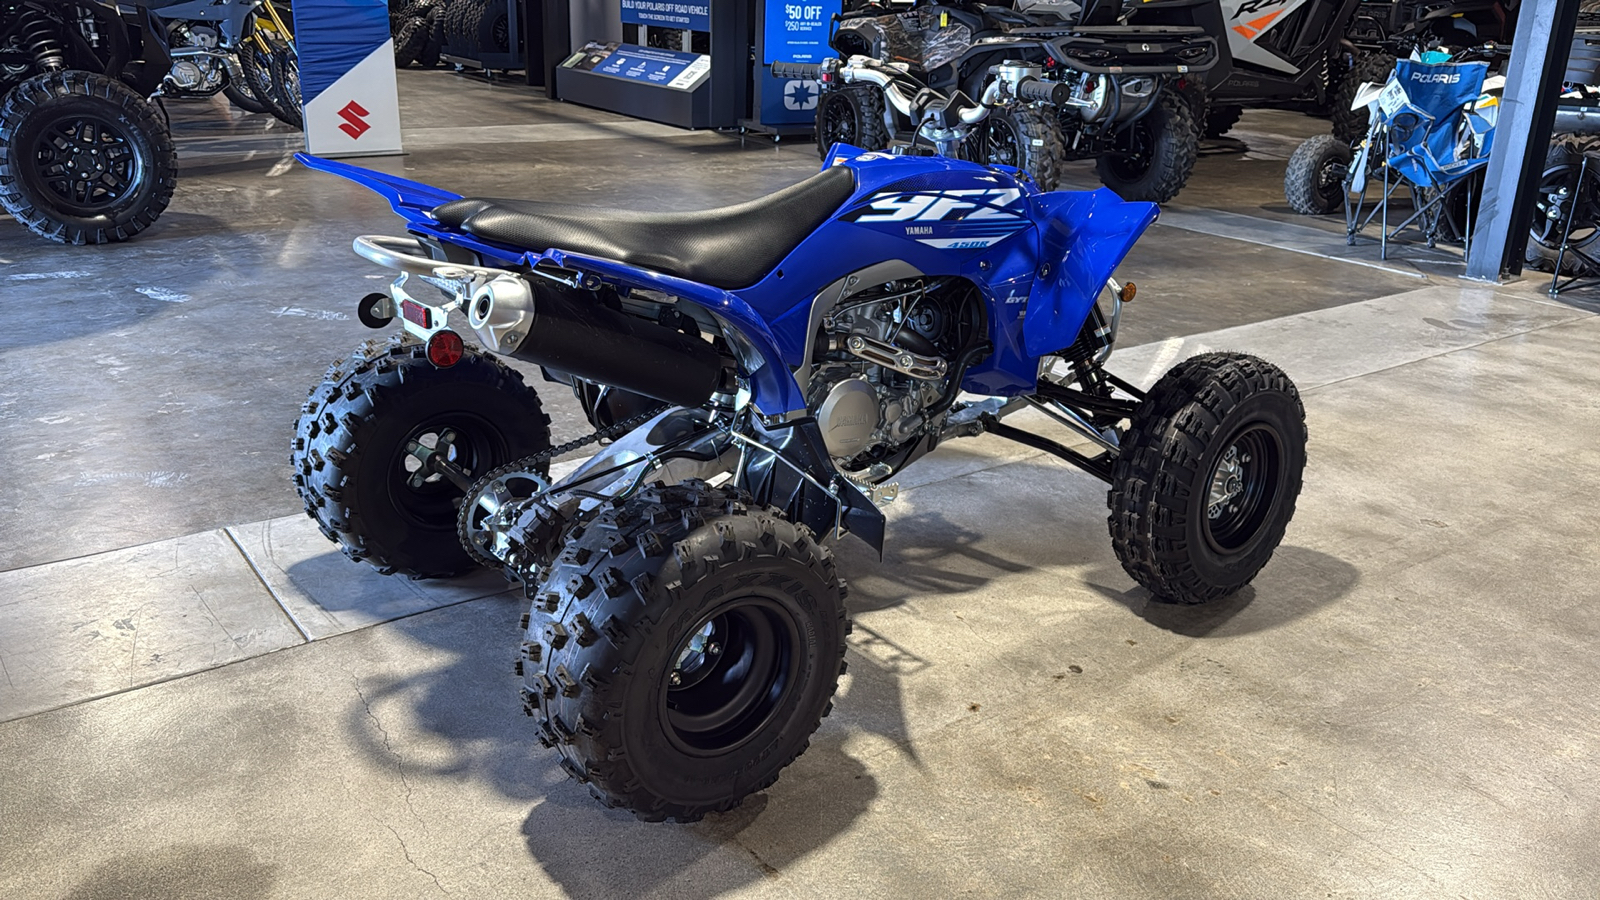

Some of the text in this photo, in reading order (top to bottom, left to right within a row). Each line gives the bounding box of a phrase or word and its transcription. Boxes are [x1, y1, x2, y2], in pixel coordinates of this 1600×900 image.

[622, 0, 708, 16] BUILD YOUR POLARIS OFF ROAD VEHICLE
[785, 3, 823, 20] $50 OFF
[785, 20, 799, 31] $250
[1227, 79, 1260, 88] POLARIS
[1410, 71, 1461, 84] POLARIS
[854, 188, 1022, 223] YFZ
[905, 226, 933, 236] YAMAHA
[946, 240, 990, 249] 450R
[665, 572, 818, 648] MAXXIS
[805, 621, 817, 649] RADIAL
